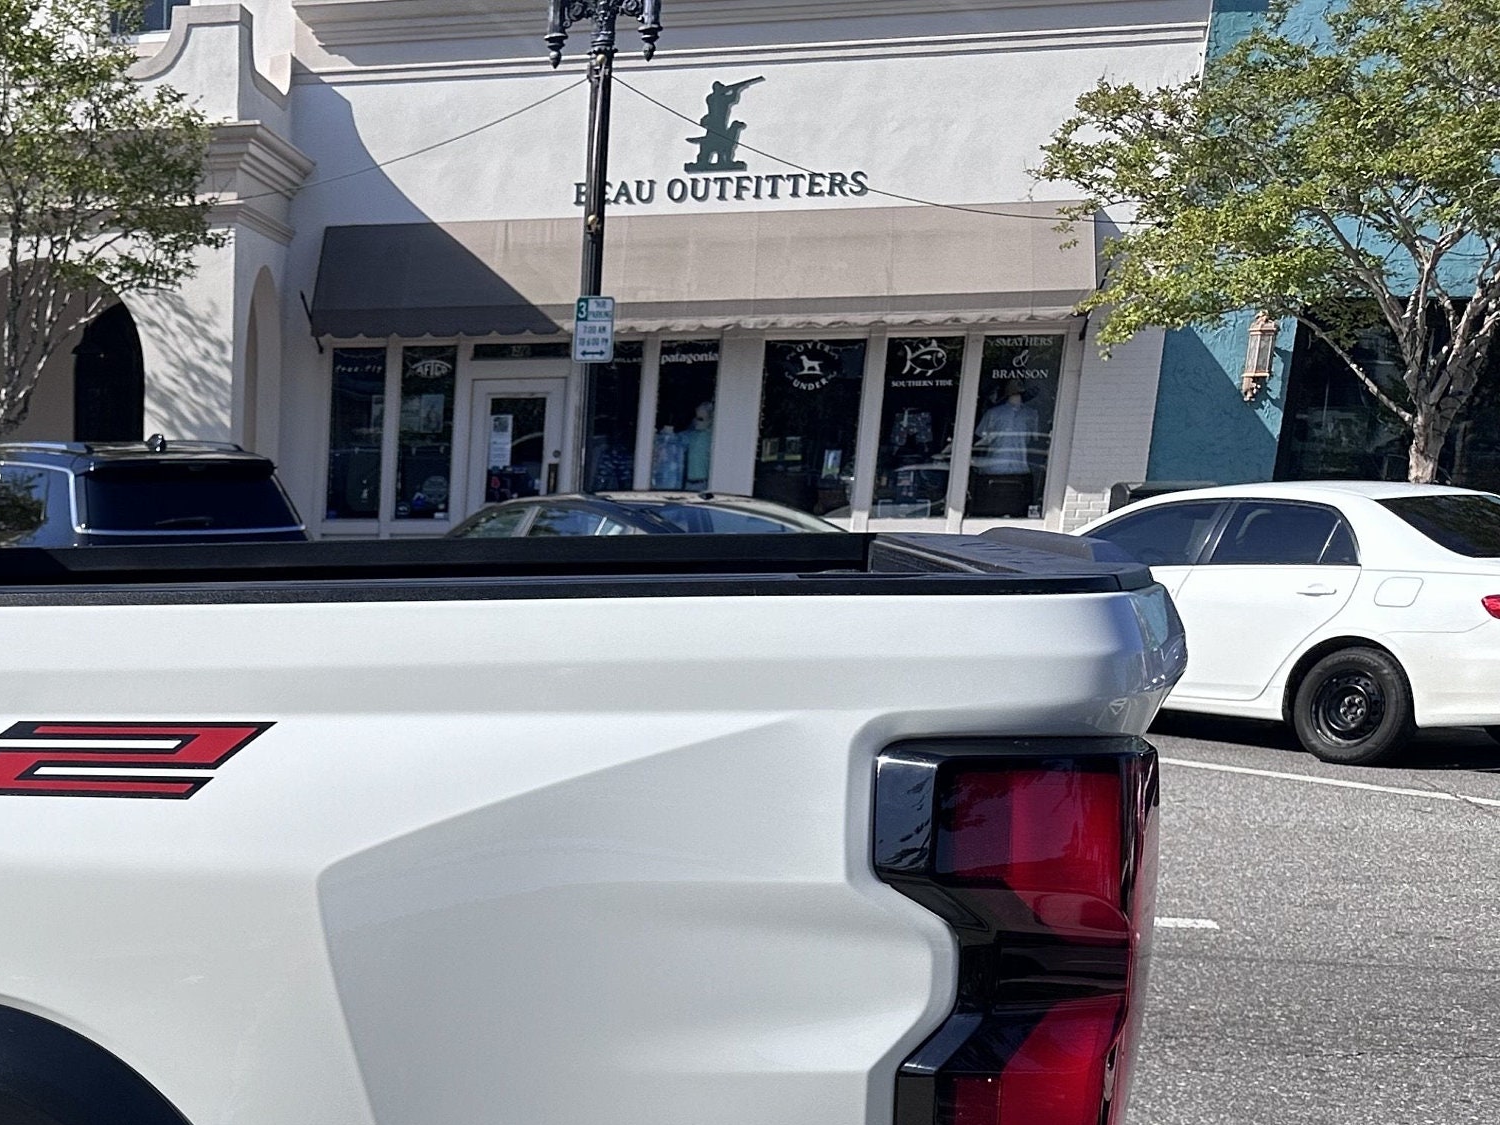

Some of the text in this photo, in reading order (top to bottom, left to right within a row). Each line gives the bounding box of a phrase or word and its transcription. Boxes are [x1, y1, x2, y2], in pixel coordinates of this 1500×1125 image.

[666, 171, 869, 203] OUTFITTERS
[578, 301, 587, 319] 3
[796, 342, 830, 353] OVER
[995, 336, 1053, 347] SMATHERS
[660, 350, 719, 365] patagonia
[992, 369, 1049, 379] BRANSON
[792, 378, 828, 391] UNDER
[891, 379, 953, 387] SOUTHERN TIDE
